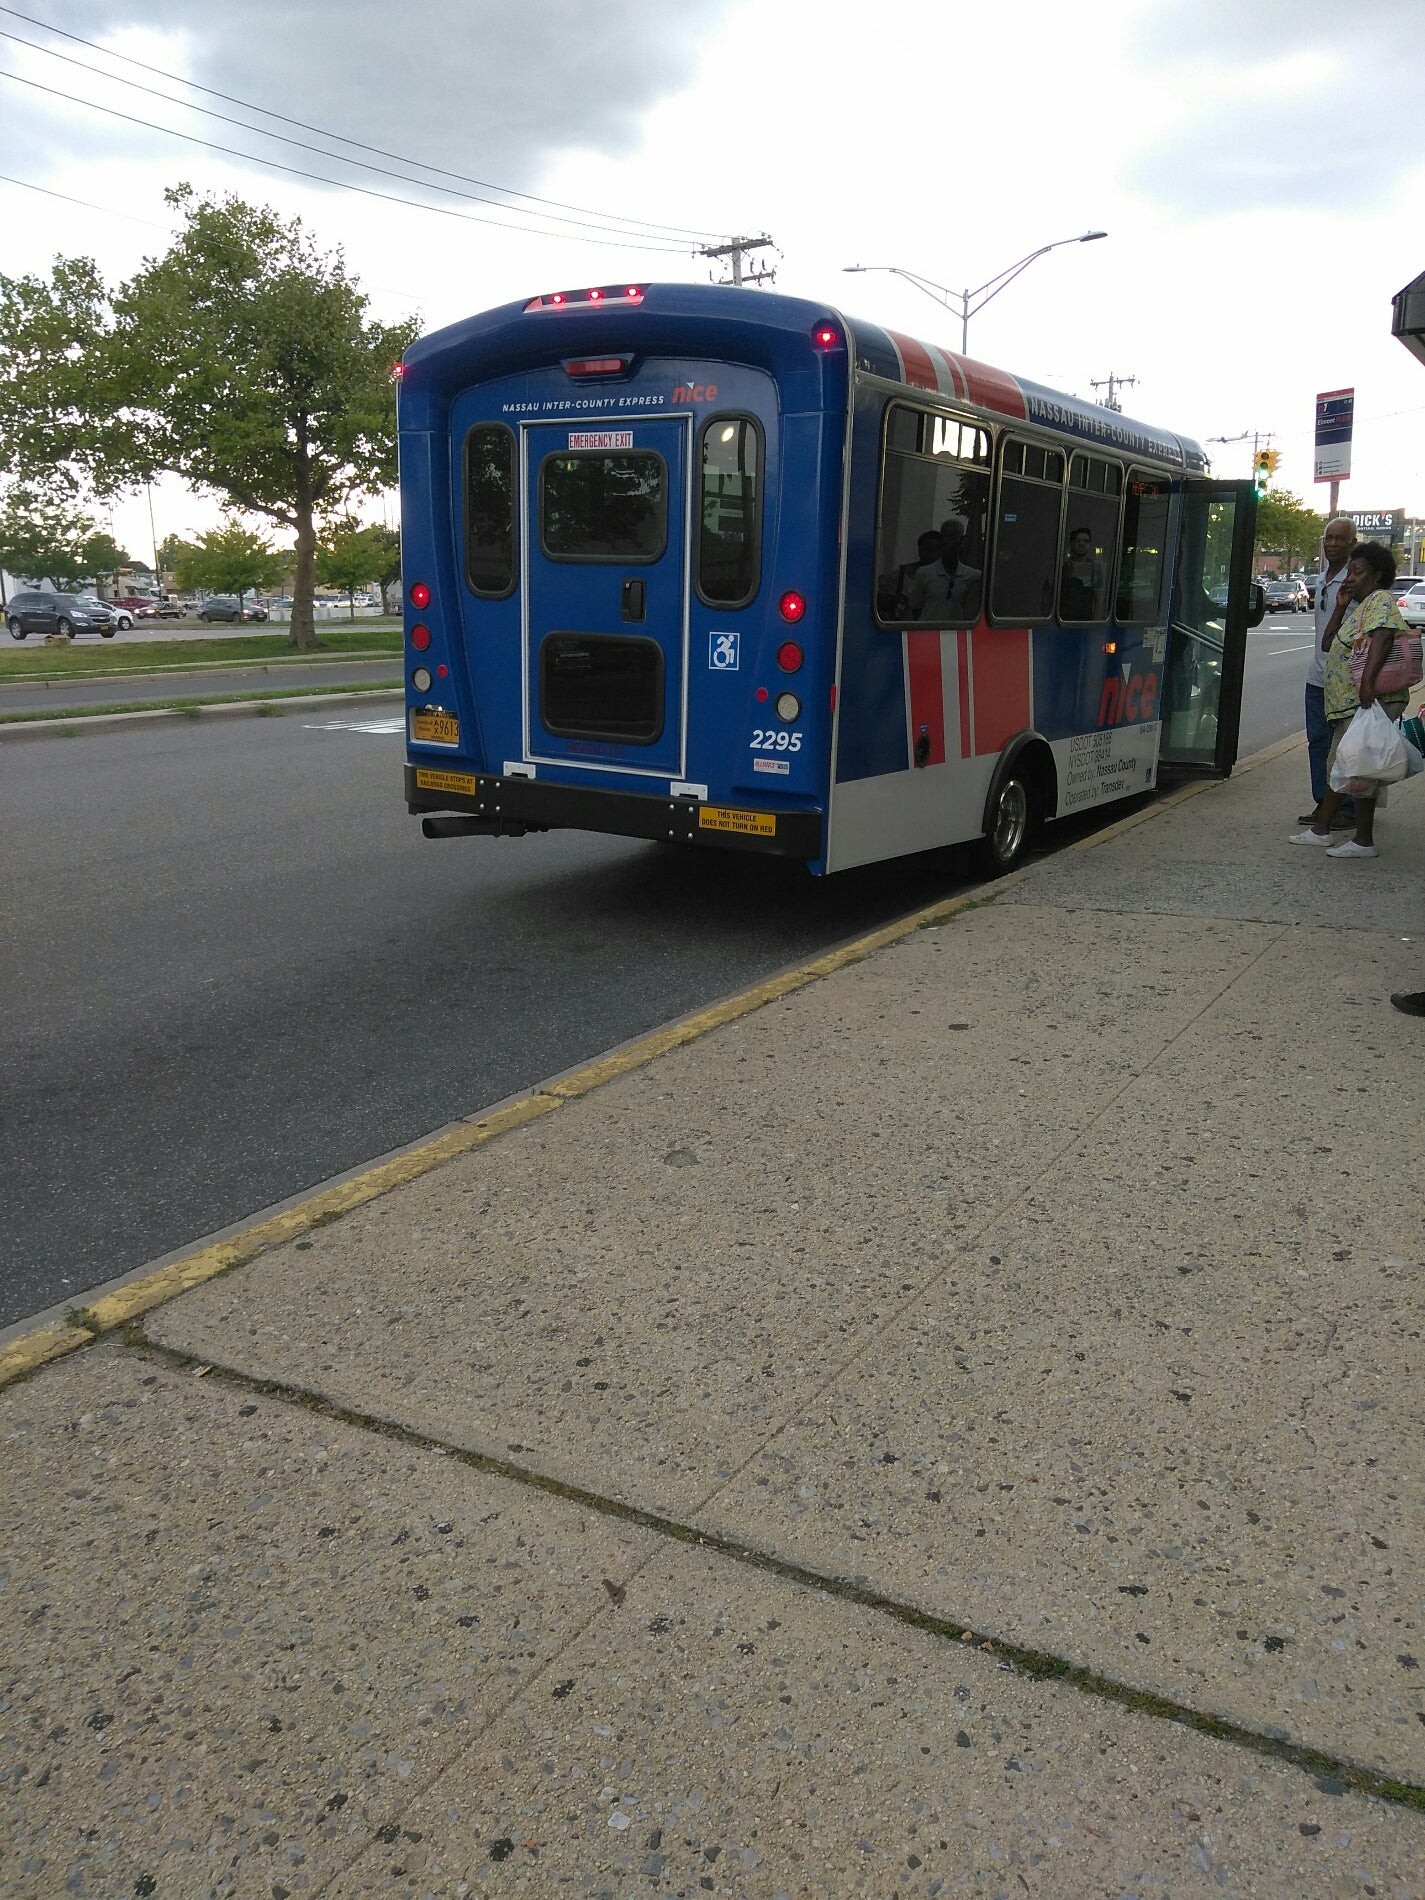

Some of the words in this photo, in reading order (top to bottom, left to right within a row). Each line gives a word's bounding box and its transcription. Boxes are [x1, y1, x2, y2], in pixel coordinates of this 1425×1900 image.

[672, 382, 719, 404] nice
[502, 402, 540, 413] NASSAU
[542, 398, 616, 411] INTER-COUNTY
[618, 395, 665, 406] EXPRESS
[1031, 397, 1075, 427] NASSAU
[1078, 414, 1145, 450] INTER-COUNTY
[1148, 438, 1182, 458] EXPRESS
[569, 434, 613, 449] EMERGENCY
[615, 433, 633, 447] EXIT
[1353, 513, 1393, 526] DICK'S
[1097, 663, 1158, 727] nice
[749, 729, 803, 752] 2295
[1070, 734, 1092, 752] USDOT
[1068, 750, 1094, 769] NYSDOT
[1067, 768, 1087, 786] Owned
[1097, 763, 1118, 778] Nassau
[1118, 757, 1137, 773] County
[1065, 787, 1091, 806] Operated
[1101, 779, 1125, 795] Transdev
[717, 810, 731, 819] THIS
[732, 812, 757, 822] VEHICLE
[701, 818, 718, 827] DOES
[718, 820, 731, 829] NOT
[732, 822, 748, 831] TURN
[749, 824, 759, 832] ON
[760, 825, 773, 834] RED
